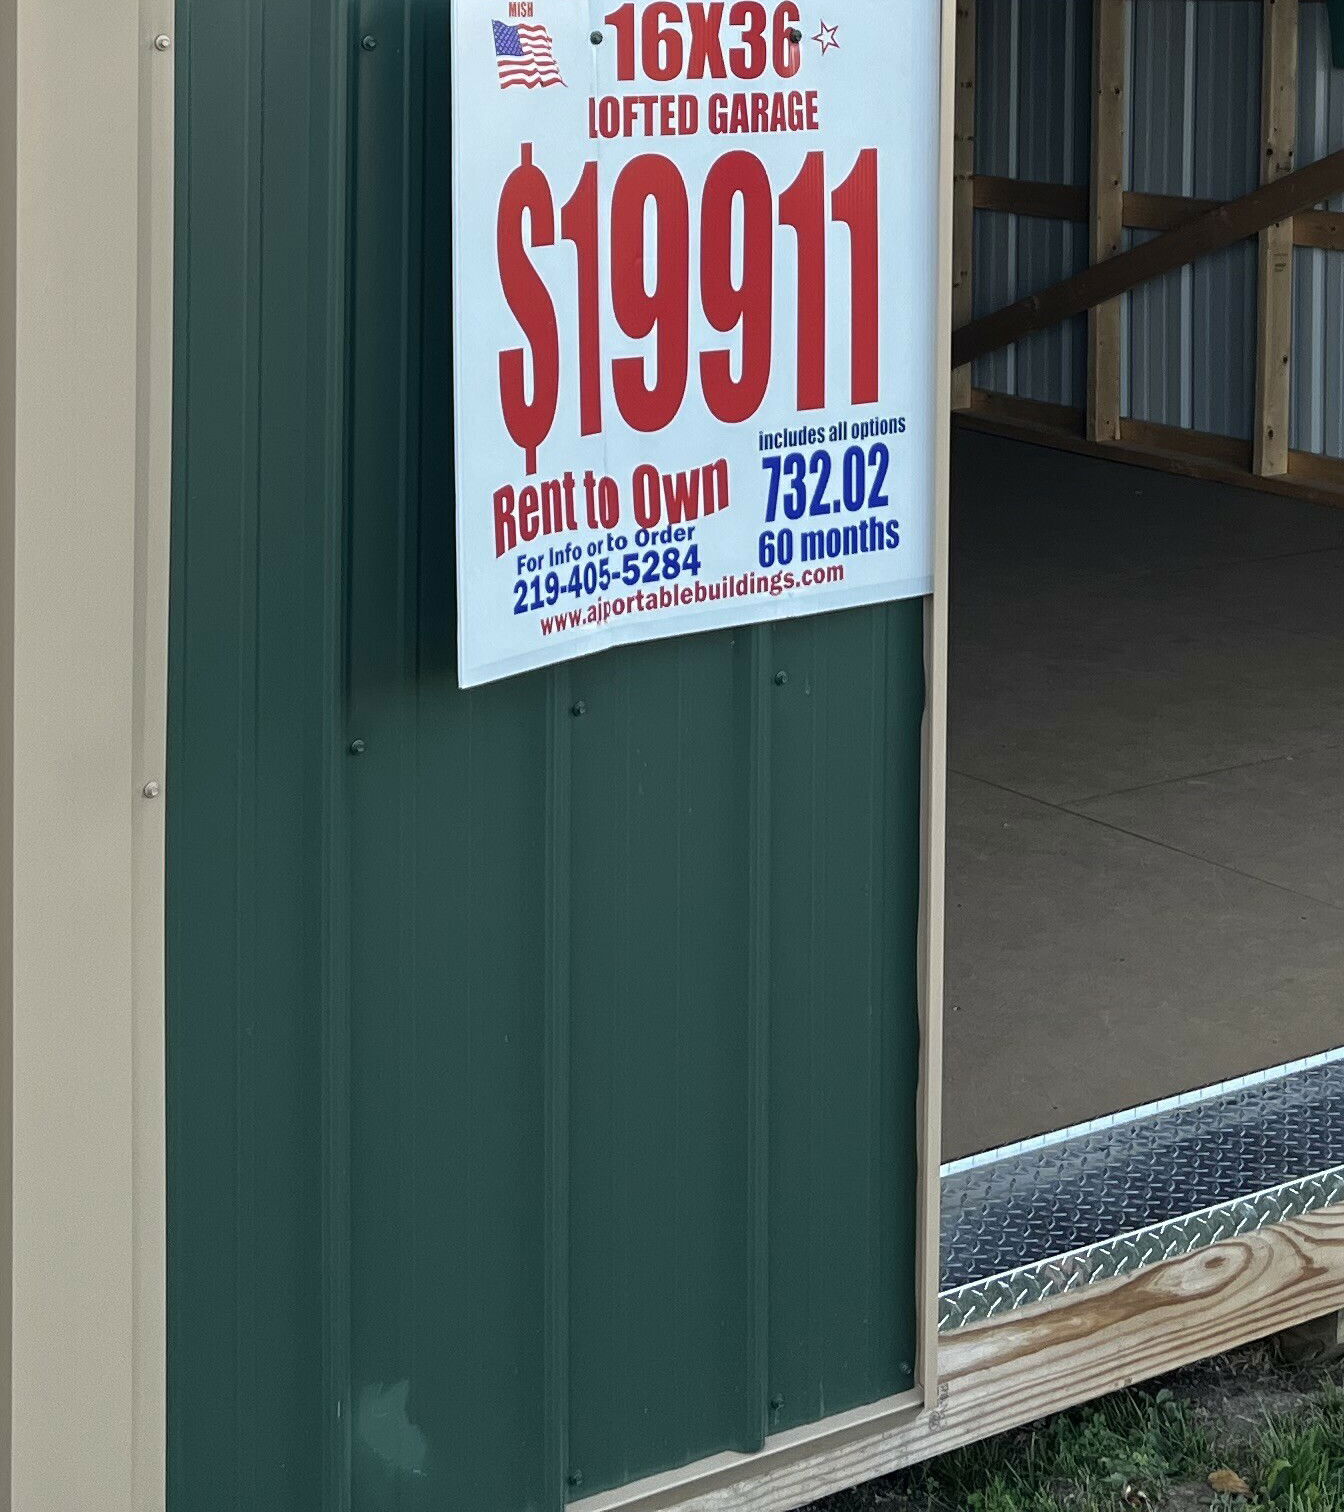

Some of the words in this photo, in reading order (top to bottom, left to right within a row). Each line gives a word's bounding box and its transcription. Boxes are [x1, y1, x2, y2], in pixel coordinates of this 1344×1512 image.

[508, 1, 534, 18] MISH
[604, 0, 802, 81] 16X36
[588, 92, 698, 139] LOFTED
[708, 90, 819, 134] GARAGE
[496, 142, 879, 476] $19911
[758, 424, 825, 451] includes
[828, 420, 847, 443] all
[850, 415, 906, 441] options
[492, 471, 578, 559] Rent
[583, 470, 620, 531] to
[632, 457, 730, 529] Own
[761, 442, 890, 523] 732.02
[517, 550, 544, 575] For
[549, 544, 582, 569] Info
[586, 540, 604, 557] or
[603, 533, 627, 552] to
[634, 525, 696, 548] Order
[758, 529, 796, 568] 60
[800, 518, 900, 563] months
[513, 544, 702, 616] 219-405-5284
[540, 564, 844, 636] www.ajportablebuildings.com
